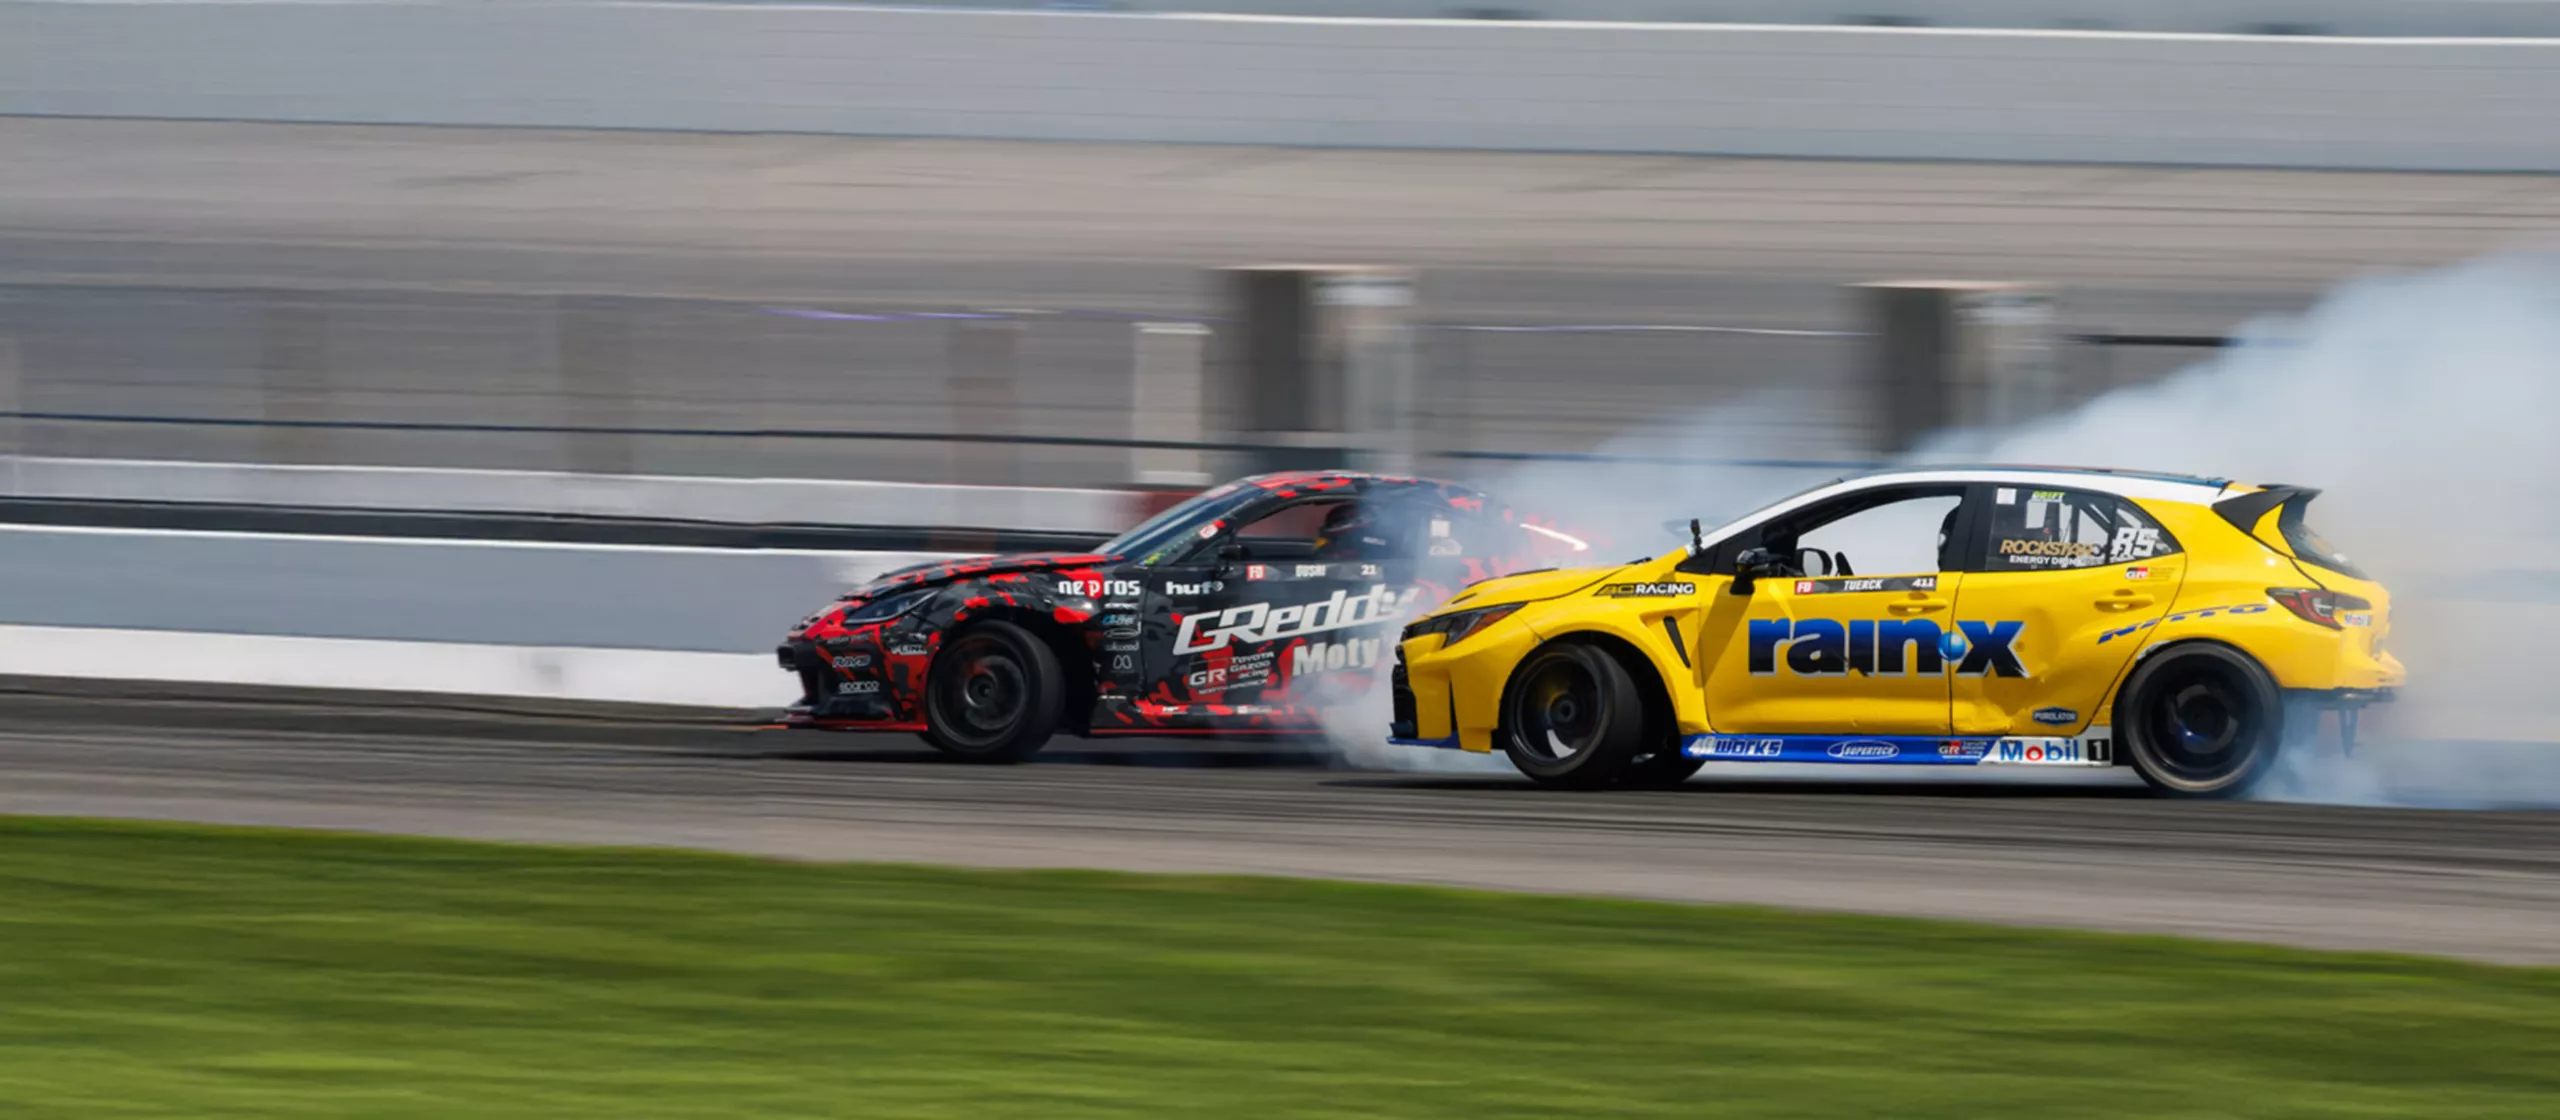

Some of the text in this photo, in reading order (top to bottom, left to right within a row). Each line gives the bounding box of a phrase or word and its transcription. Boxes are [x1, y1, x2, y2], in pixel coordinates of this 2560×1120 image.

[2000, 539, 2094, 556] ROCKSTAR
[2009, 555, 2049, 565] ENERGY
[1361, 565, 1376, 575] 21
[1058, 580, 1140, 596] nepros
[1635, 584, 1694, 594] RACING
[1844, 579, 1883, 591] TUERCK
[1912, 578, 1934, 587] 411
[2097, 604, 2268, 645] NITTO
[1230, 652, 1275, 663] TOYOTA
[1229, 661, 1271, 672] GAZOO
[1189, 669, 1227, 686] GR
[839, 681, 880, 694] sparco
[1939, 746, 1961, 755] GR
[2000, 740, 2079, 761] Mobil
